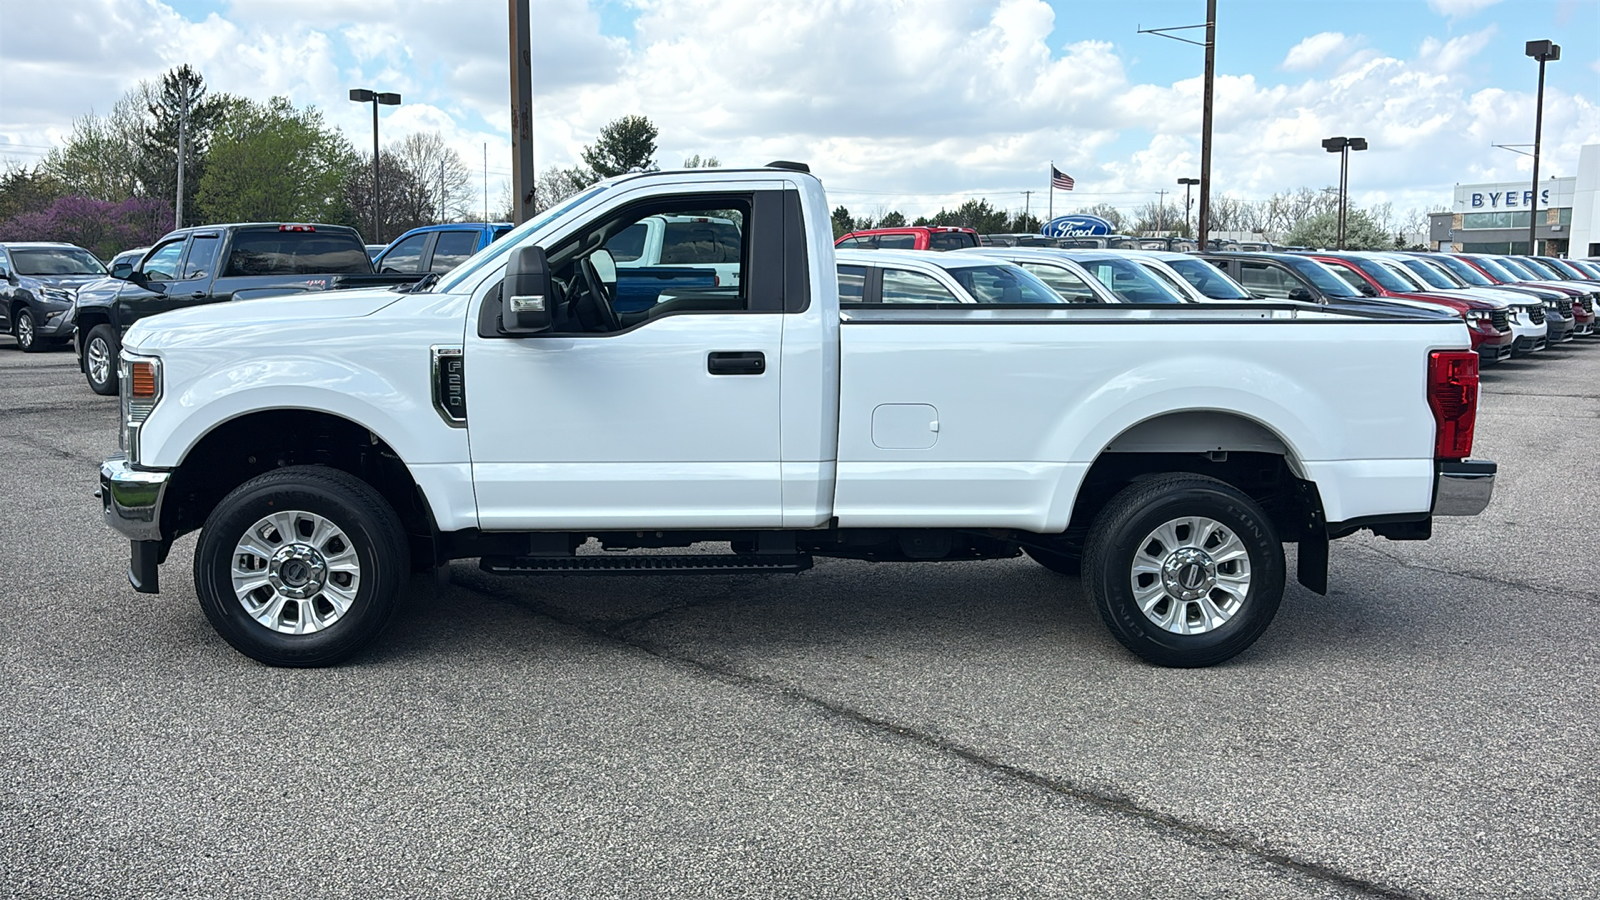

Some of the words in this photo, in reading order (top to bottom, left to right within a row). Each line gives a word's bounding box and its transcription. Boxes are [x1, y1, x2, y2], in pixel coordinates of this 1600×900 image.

[1472, 189, 1549, 208] BYERS
[1054, 221, 1096, 237] Ford
[447, 361, 462, 406] F250
